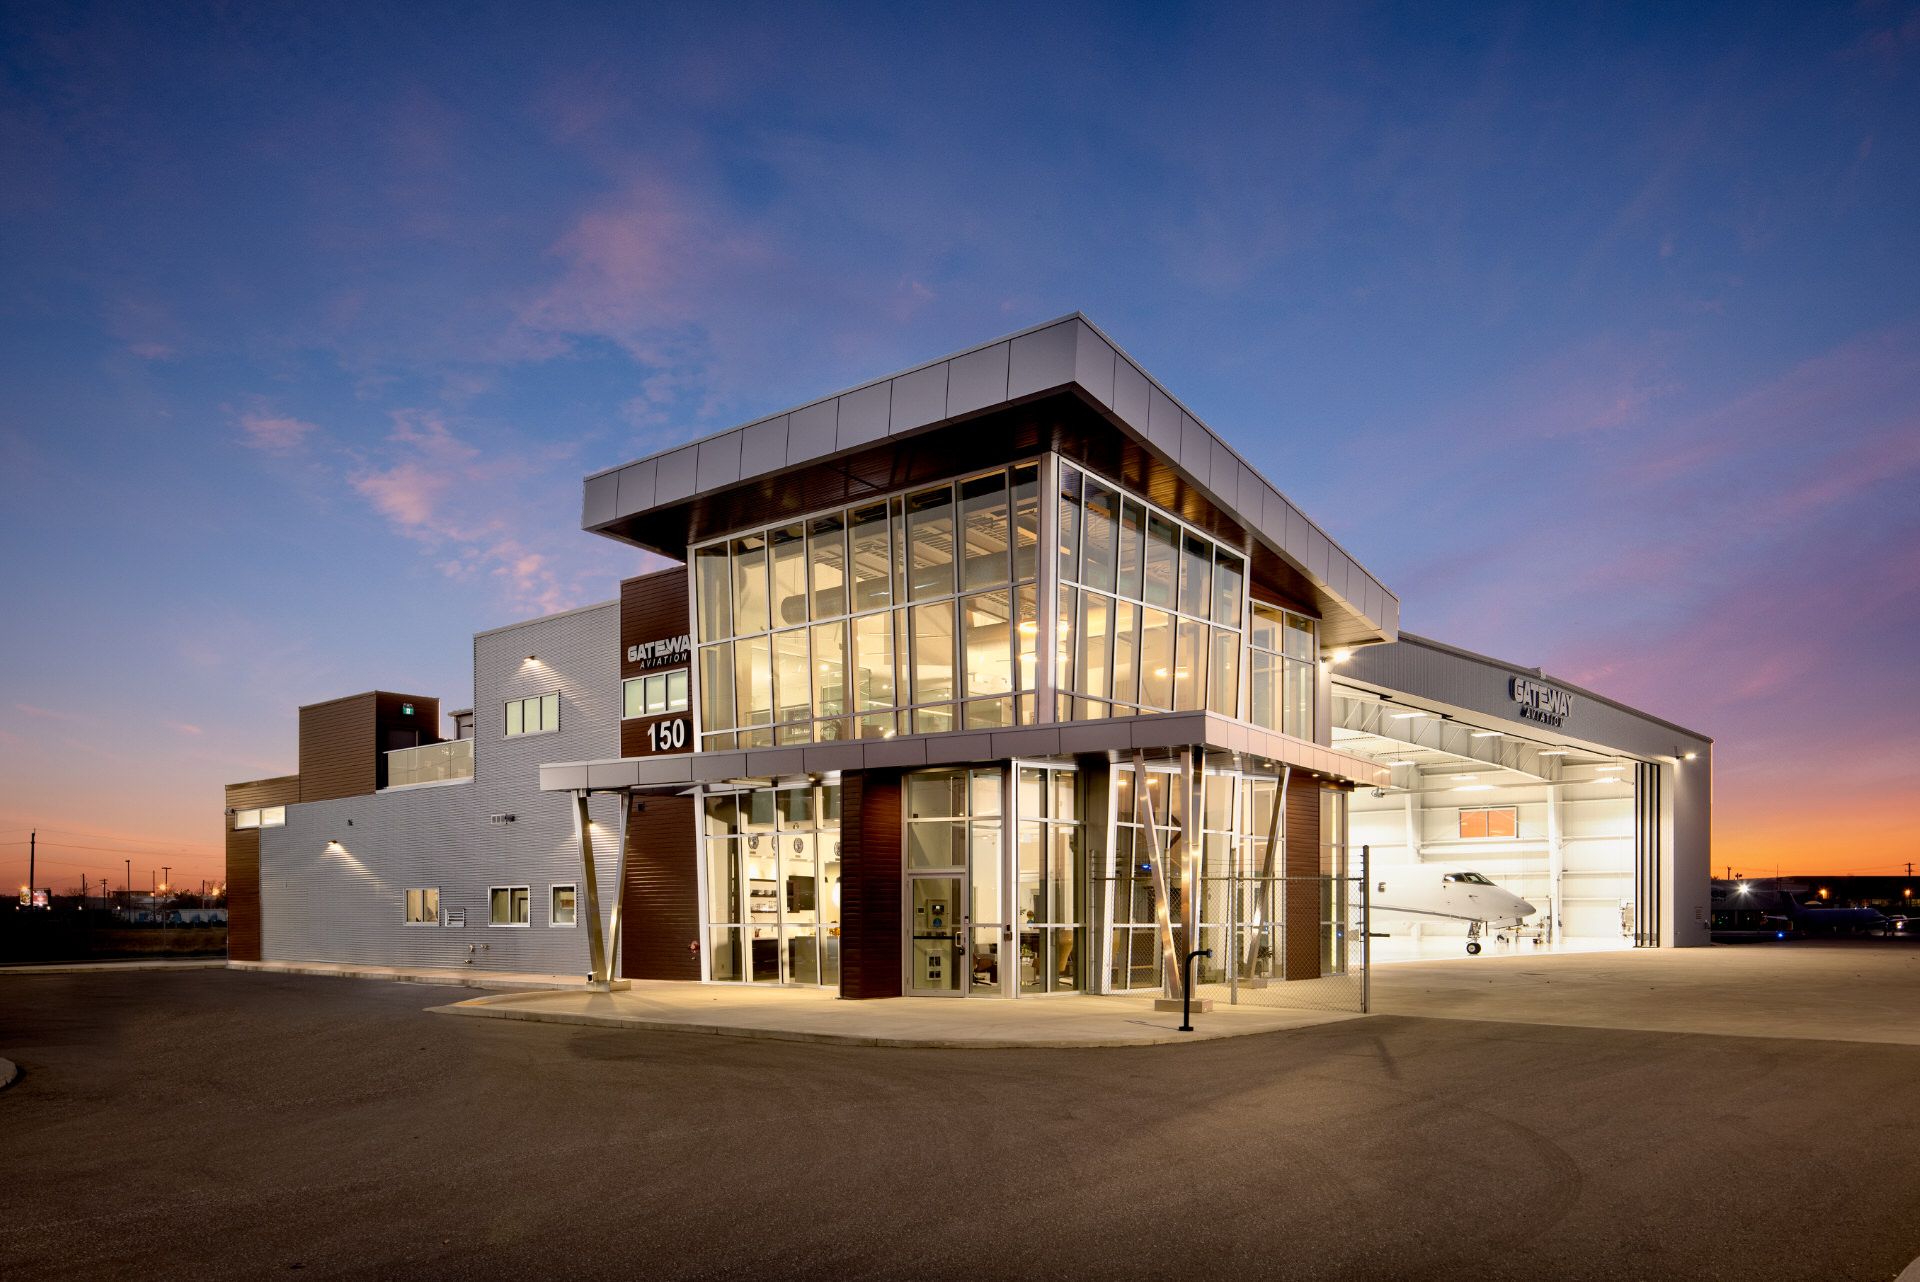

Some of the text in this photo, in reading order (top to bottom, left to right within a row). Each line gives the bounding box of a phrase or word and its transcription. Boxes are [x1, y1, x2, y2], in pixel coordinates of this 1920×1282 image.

[627, 634, 692, 663] GATEWA
[640, 652, 687, 670] AVIATION
[1514, 678, 1574, 717] GATEWAY
[1525, 707, 1564, 728] AVIATION
[647, 718, 685, 752] 150
